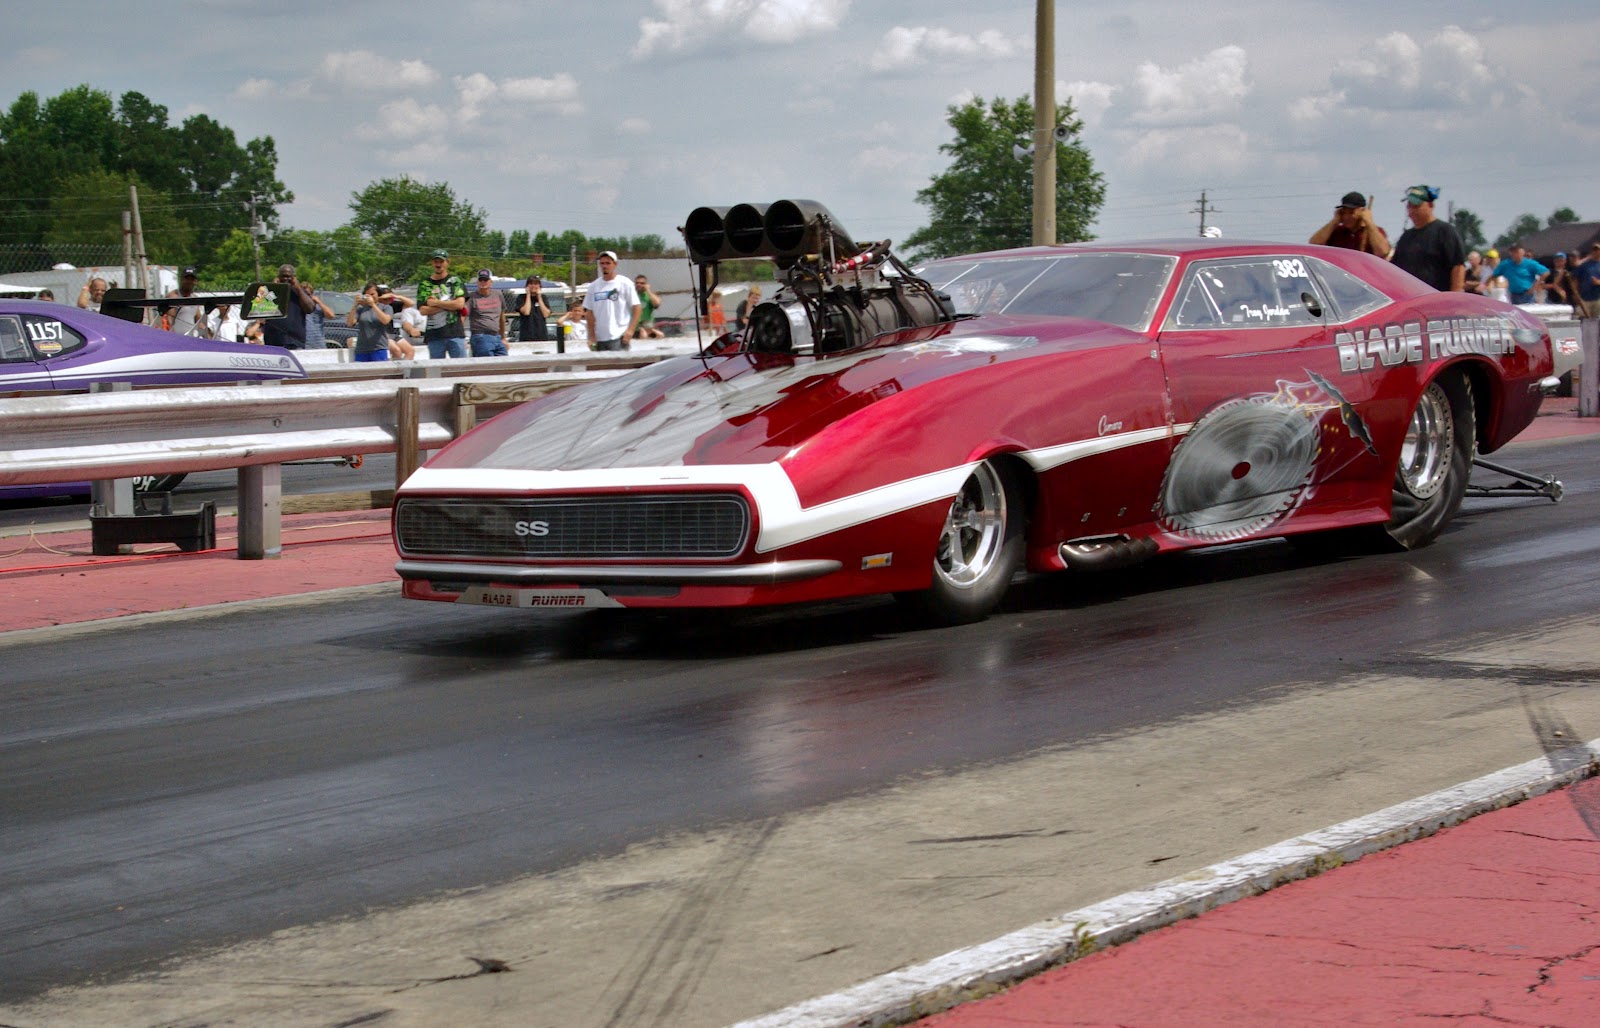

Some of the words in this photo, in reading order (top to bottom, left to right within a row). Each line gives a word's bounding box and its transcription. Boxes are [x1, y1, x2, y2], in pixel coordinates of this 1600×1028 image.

[1272, 259, 1309, 278] 382
[26, 321, 63, 341] 1157
[1335, 322, 1423, 372] BLADE
[1427, 318, 1516, 359] RUNNER
[515, 520, 550, 536] SS
[482, 593, 512, 605] BLADE
[531, 595, 586, 606] RUNNER
